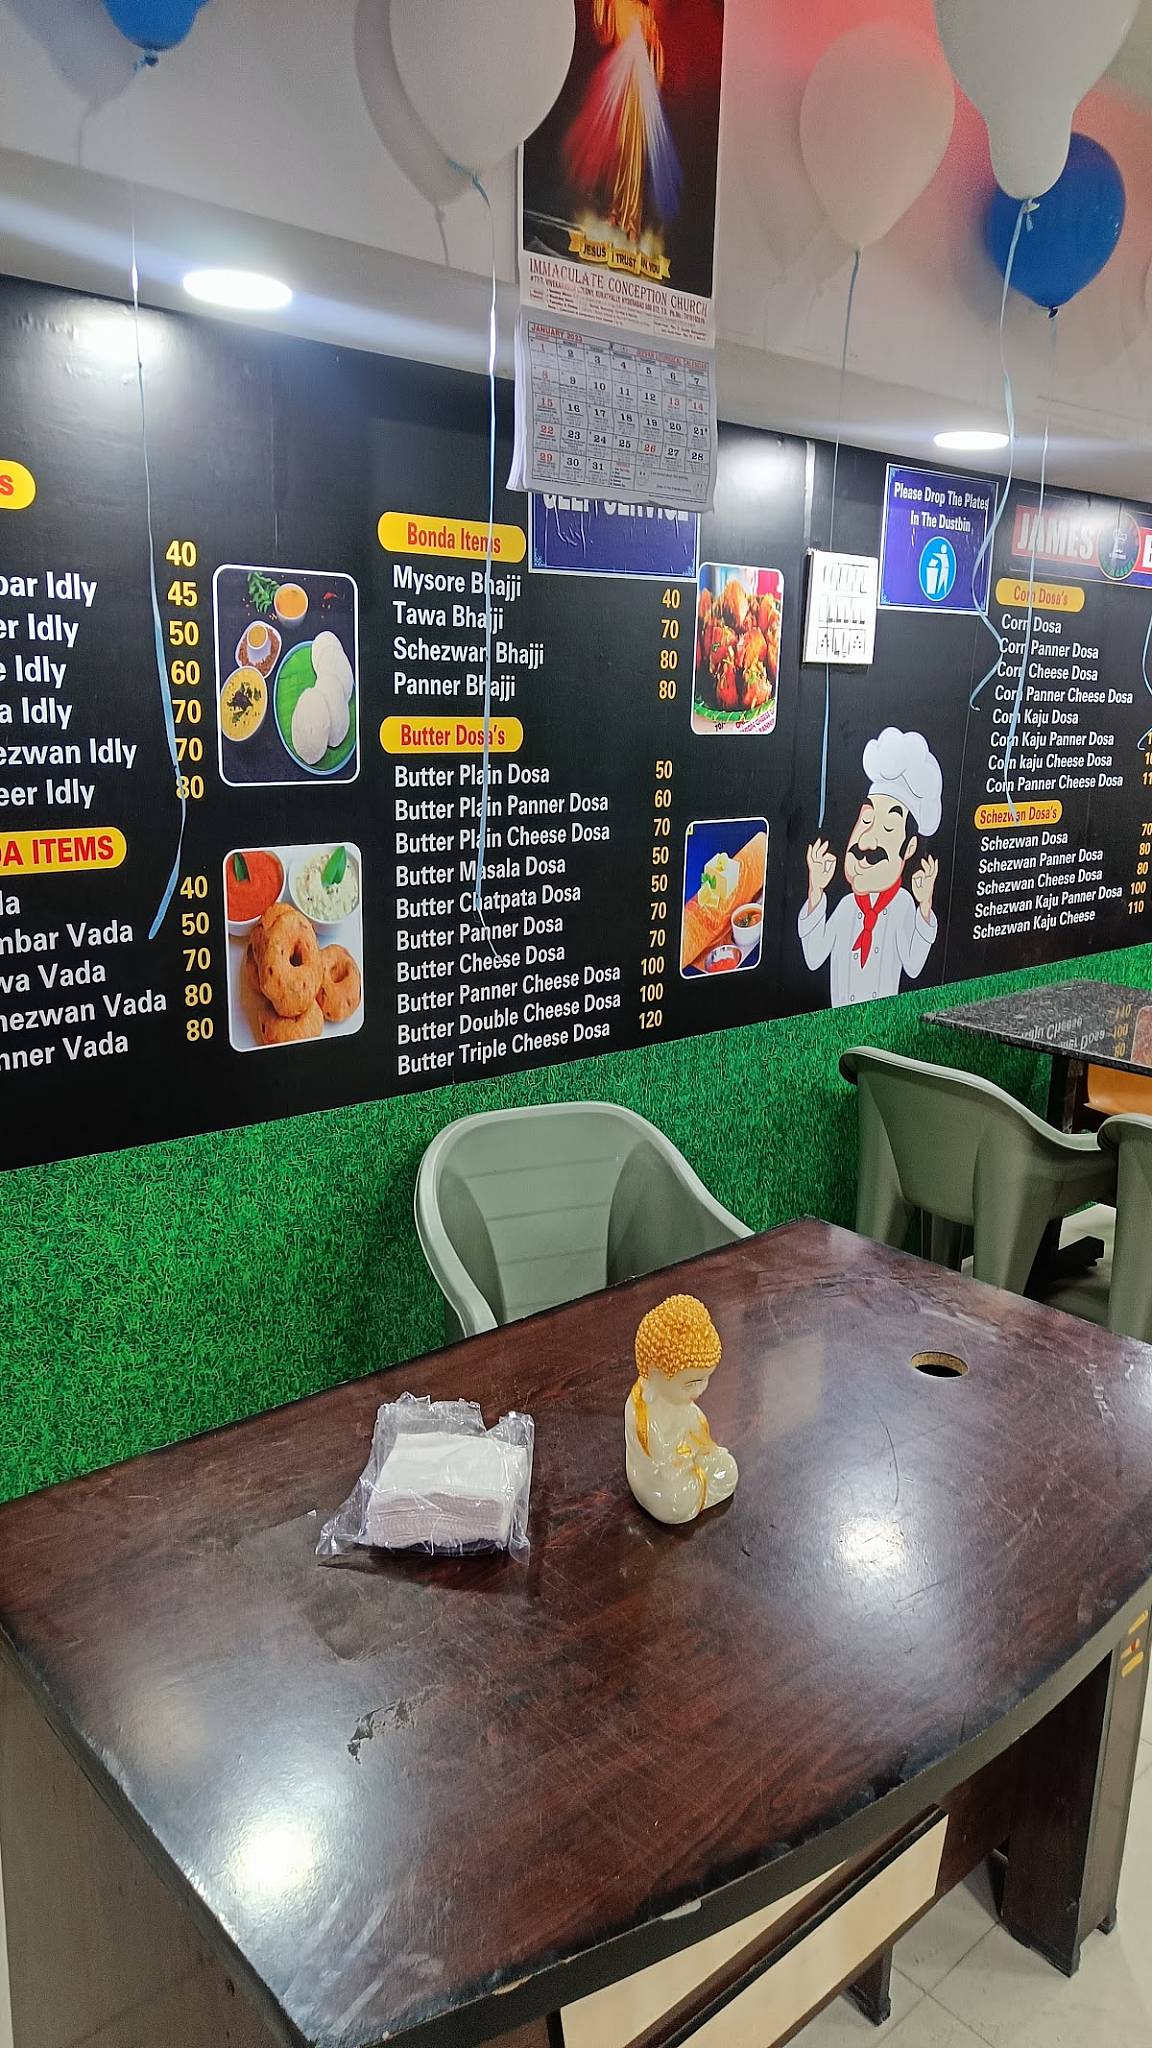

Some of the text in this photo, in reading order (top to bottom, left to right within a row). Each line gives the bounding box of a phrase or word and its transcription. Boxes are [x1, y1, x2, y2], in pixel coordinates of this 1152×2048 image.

[583, 244, 607, 258] JESUS
[616, 252, 637, 268] TRUST
[640, 257, 648, 269] IN
[648, 260, 660, 274] YOU
[530, 257, 604, 289] IMMACULATE
[608, 276, 667, 306] CONCEPTION
[671, 294, 708, 318] CHURCH
[531, 323, 564, 339] JANUARY
[567, 403, 581, 413] 16
[567, 429, 581, 440] 23
[618, 439, 631, 449] 25
[566, 457, 580, 467] 30
[592, 461, 604, 471] 31
[894, 482, 990, 511] Please Drop The Plates
[910, 509, 971, 533] In The Dustbin
[407, 521, 501, 554] Bonda Items
[1016, 512, 1094, 560] JAMES
[166, 541, 197, 567] 40
[46, 571, 97, 607] Idly
[168, 581, 198, 607] 45
[392, 564, 522, 602] Mysore Bhajji
[662, 588, 681, 609] 40
[1039, 589, 1068, 606] Dosa's
[392, 601, 446, 627] Tawa
[1033, 616, 1062, 634] Dosa
[28, 613, 79, 648] Idly
[169, 621, 199, 646] 50
[661, 619, 680, 639] 70
[495, 641, 545, 670] Bhajji
[659, 649, 679, 671] 80
[1031, 640, 1099, 660] Panner Dosa
[15, 655, 67, 689] Idly
[170, 660, 201, 685] 60
[1028, 663, 1098, 682] Cheese Dosa
[394, 672, 516, 701] Panner Bhajji
[658, 680, 678, 701] 80
[1026, 686, 1133, 704] Panner Cheese Dosa
[22, 697, 73, 730] Idly
[172, 699, 202, 724] 70
[1024, 709, 1079, 728] Kaju Dosa
[400, 724, 506, 747] Butter Dosa's
[1021, 731, 1114, 750] Kaju Panner Dosa
[89, 738, 137, 769] Idly
[175, 737, 203, 762] 70
[655, 760, 673, 780] 50
[1020, 752, 1112, 773] kaju Cheese Dosa
[176, 775, 205, 799] 80
[395, 764, 550, 788] Butter Plain Dosa
[986, 773, 1123, 794] Corn Panner Cheese Dosa
[46, 778, 95, 809] Idly
[654, 789, 672, 809] 60
[395, 792, 609, 822] Butter Plain Panner Dosa
[980, 806, 1057, 825] Schezwan Dosa's
[395, 822, 611, 855] Butter Plain Cheese Dosa
[653, 818, 671, 837] 70
[32, 835, 114, 865] ITEMS
[981, 831, 1068, 852] Schezwan Dosa
[1139, 842, 1150, 856] 80
[652, 846, 669, 865] 50
[979, 848, 1104, 874] Schezwan Panner Dosa
[395, 855, 566, 888] Butter Masala Dosa
[1136, 861, 1149, 875] 80
[180, 875, 208, 900] 40
[651, 874, 668, 893] 50
[976, 869, 1103, 896] Schezwan Cheese Dosa
[1130, 881, 1147, 895] 100
[396, 884, 581, 920] Butter Chatpata Dosa
[650, 901, 667, 921] 70
[974, 886, 1123, 918] Schezwan Kaju Panner Dosa
[1127, 901, 1144, 915] 110
[66, 920, 133, 948] Vada
[181, 912, 210, 936] 50
[396, 916, 563, 952] Butter Panner Dosa
[972, 909, 1096, 940] Schezwan Kaju Cheese
[649, 929, 666, 948] 70
[183, 948, 211, 972] 70
[396, 944, 565, 983] Butter Cheese Dosa
[640, 956, 665, 977] 100
[37, 960, 106, 989] Vada
[184, 983, 213, 1007] 80
[397, 964, 621, 1015] Butter Panner Cheese Dosa
[639, 983, 664, 1003] 100
[102, 989, 167, 1018] Vada
[186, 1018, 214, 1042] 80
[397, 992, 621, 1046] Butter Double Cheese Dosa
[638, 1009, 663, 1030] 120
[62, 1031, 129, 1061] Vada
[397, 1020, 611, 1076] Butter Triple Cheese Dosa
